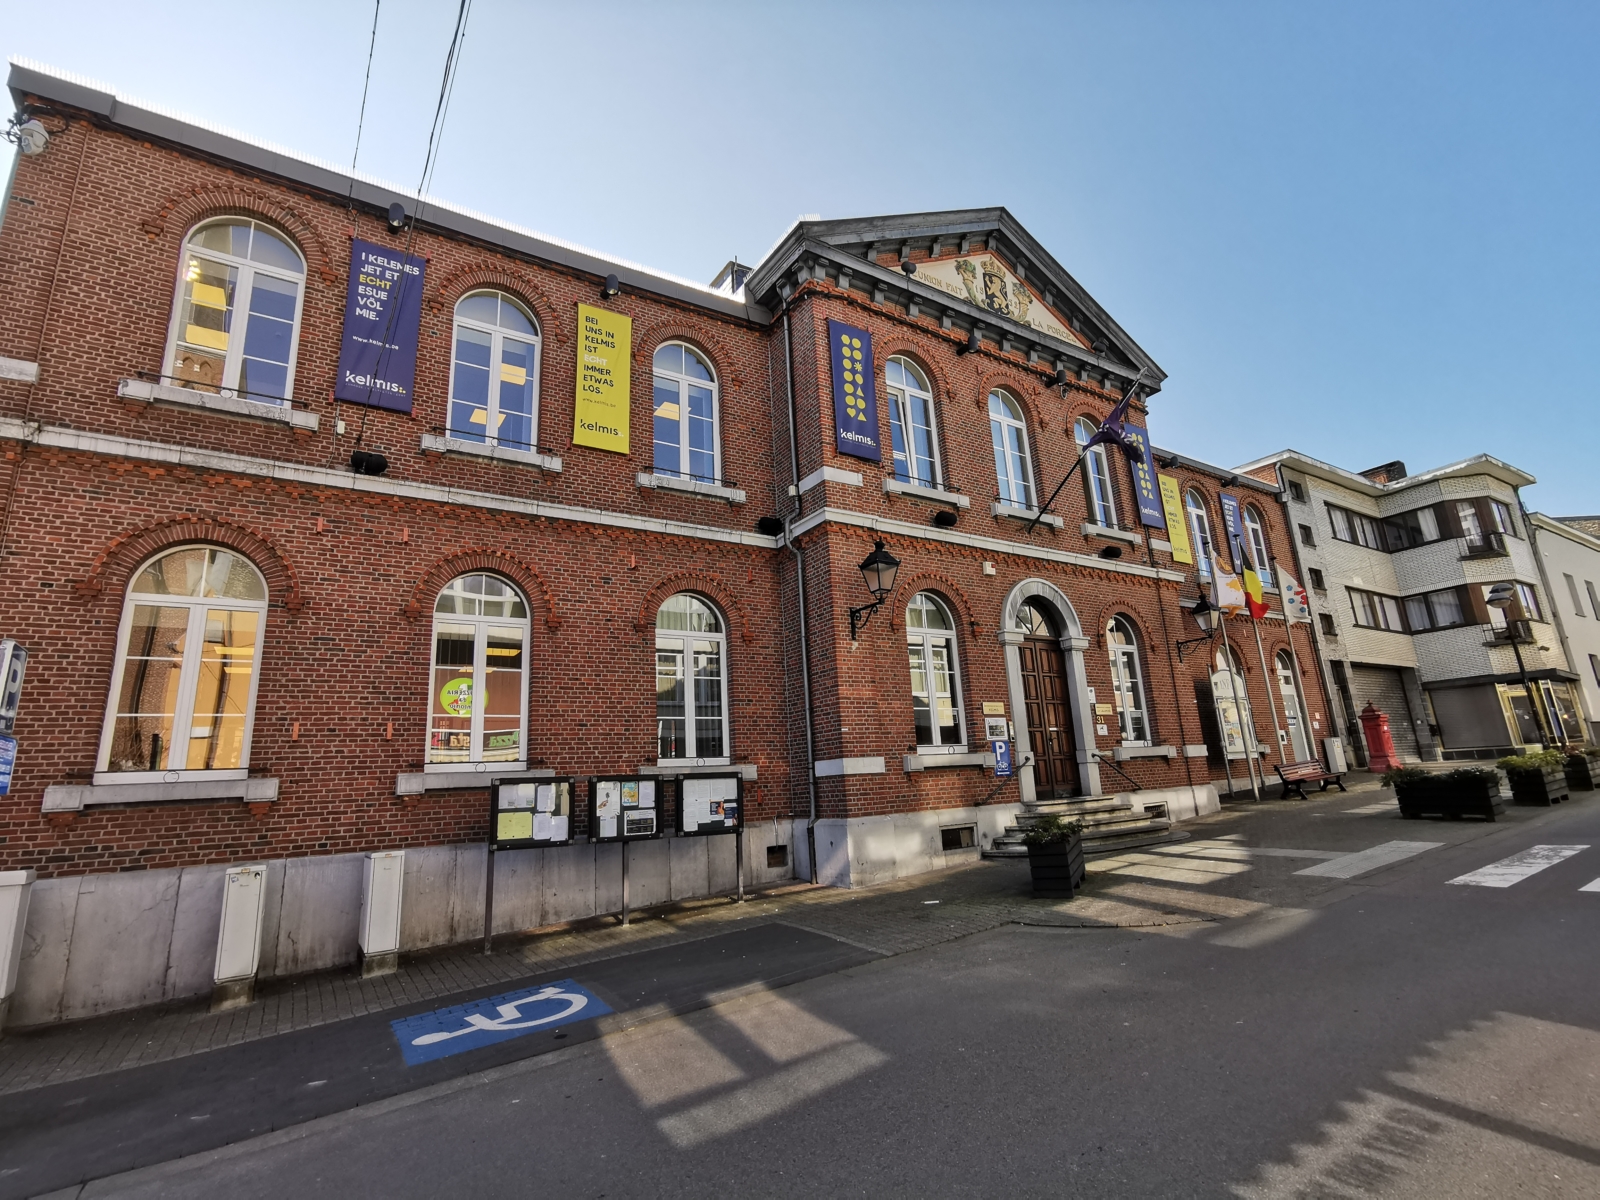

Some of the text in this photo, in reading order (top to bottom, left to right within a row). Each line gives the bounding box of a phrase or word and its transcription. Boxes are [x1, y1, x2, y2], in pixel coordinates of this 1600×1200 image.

[361, 252, 366, 261] I
[360, 264, 400, 281] JET ET
[359, 274, 392, 290] ECHT
[946, 281, 964, 296] FAIT
[358, 285, 388, 300] ESUE
[357, 296, 384, 311] VÖL
[355, 307, 380, 321] MIE.
[585, 315, 598, 325] BEI
[1032, 317, 1044, 329] LA
[585, 325, 615, 339] UNS IN
[584, 344, 598, 353] IST
[585, 334, 616, 349] KELMIS
[584, 353, 608, 366] ECHT
[583, 364, 612, 376] IMMER
[583, 374, 614, 388] ETWAS
[582, 384, 603, 395] LOS.
[1096, 715, 1105, 724] 31
[995, 741, 1006, 761] P
